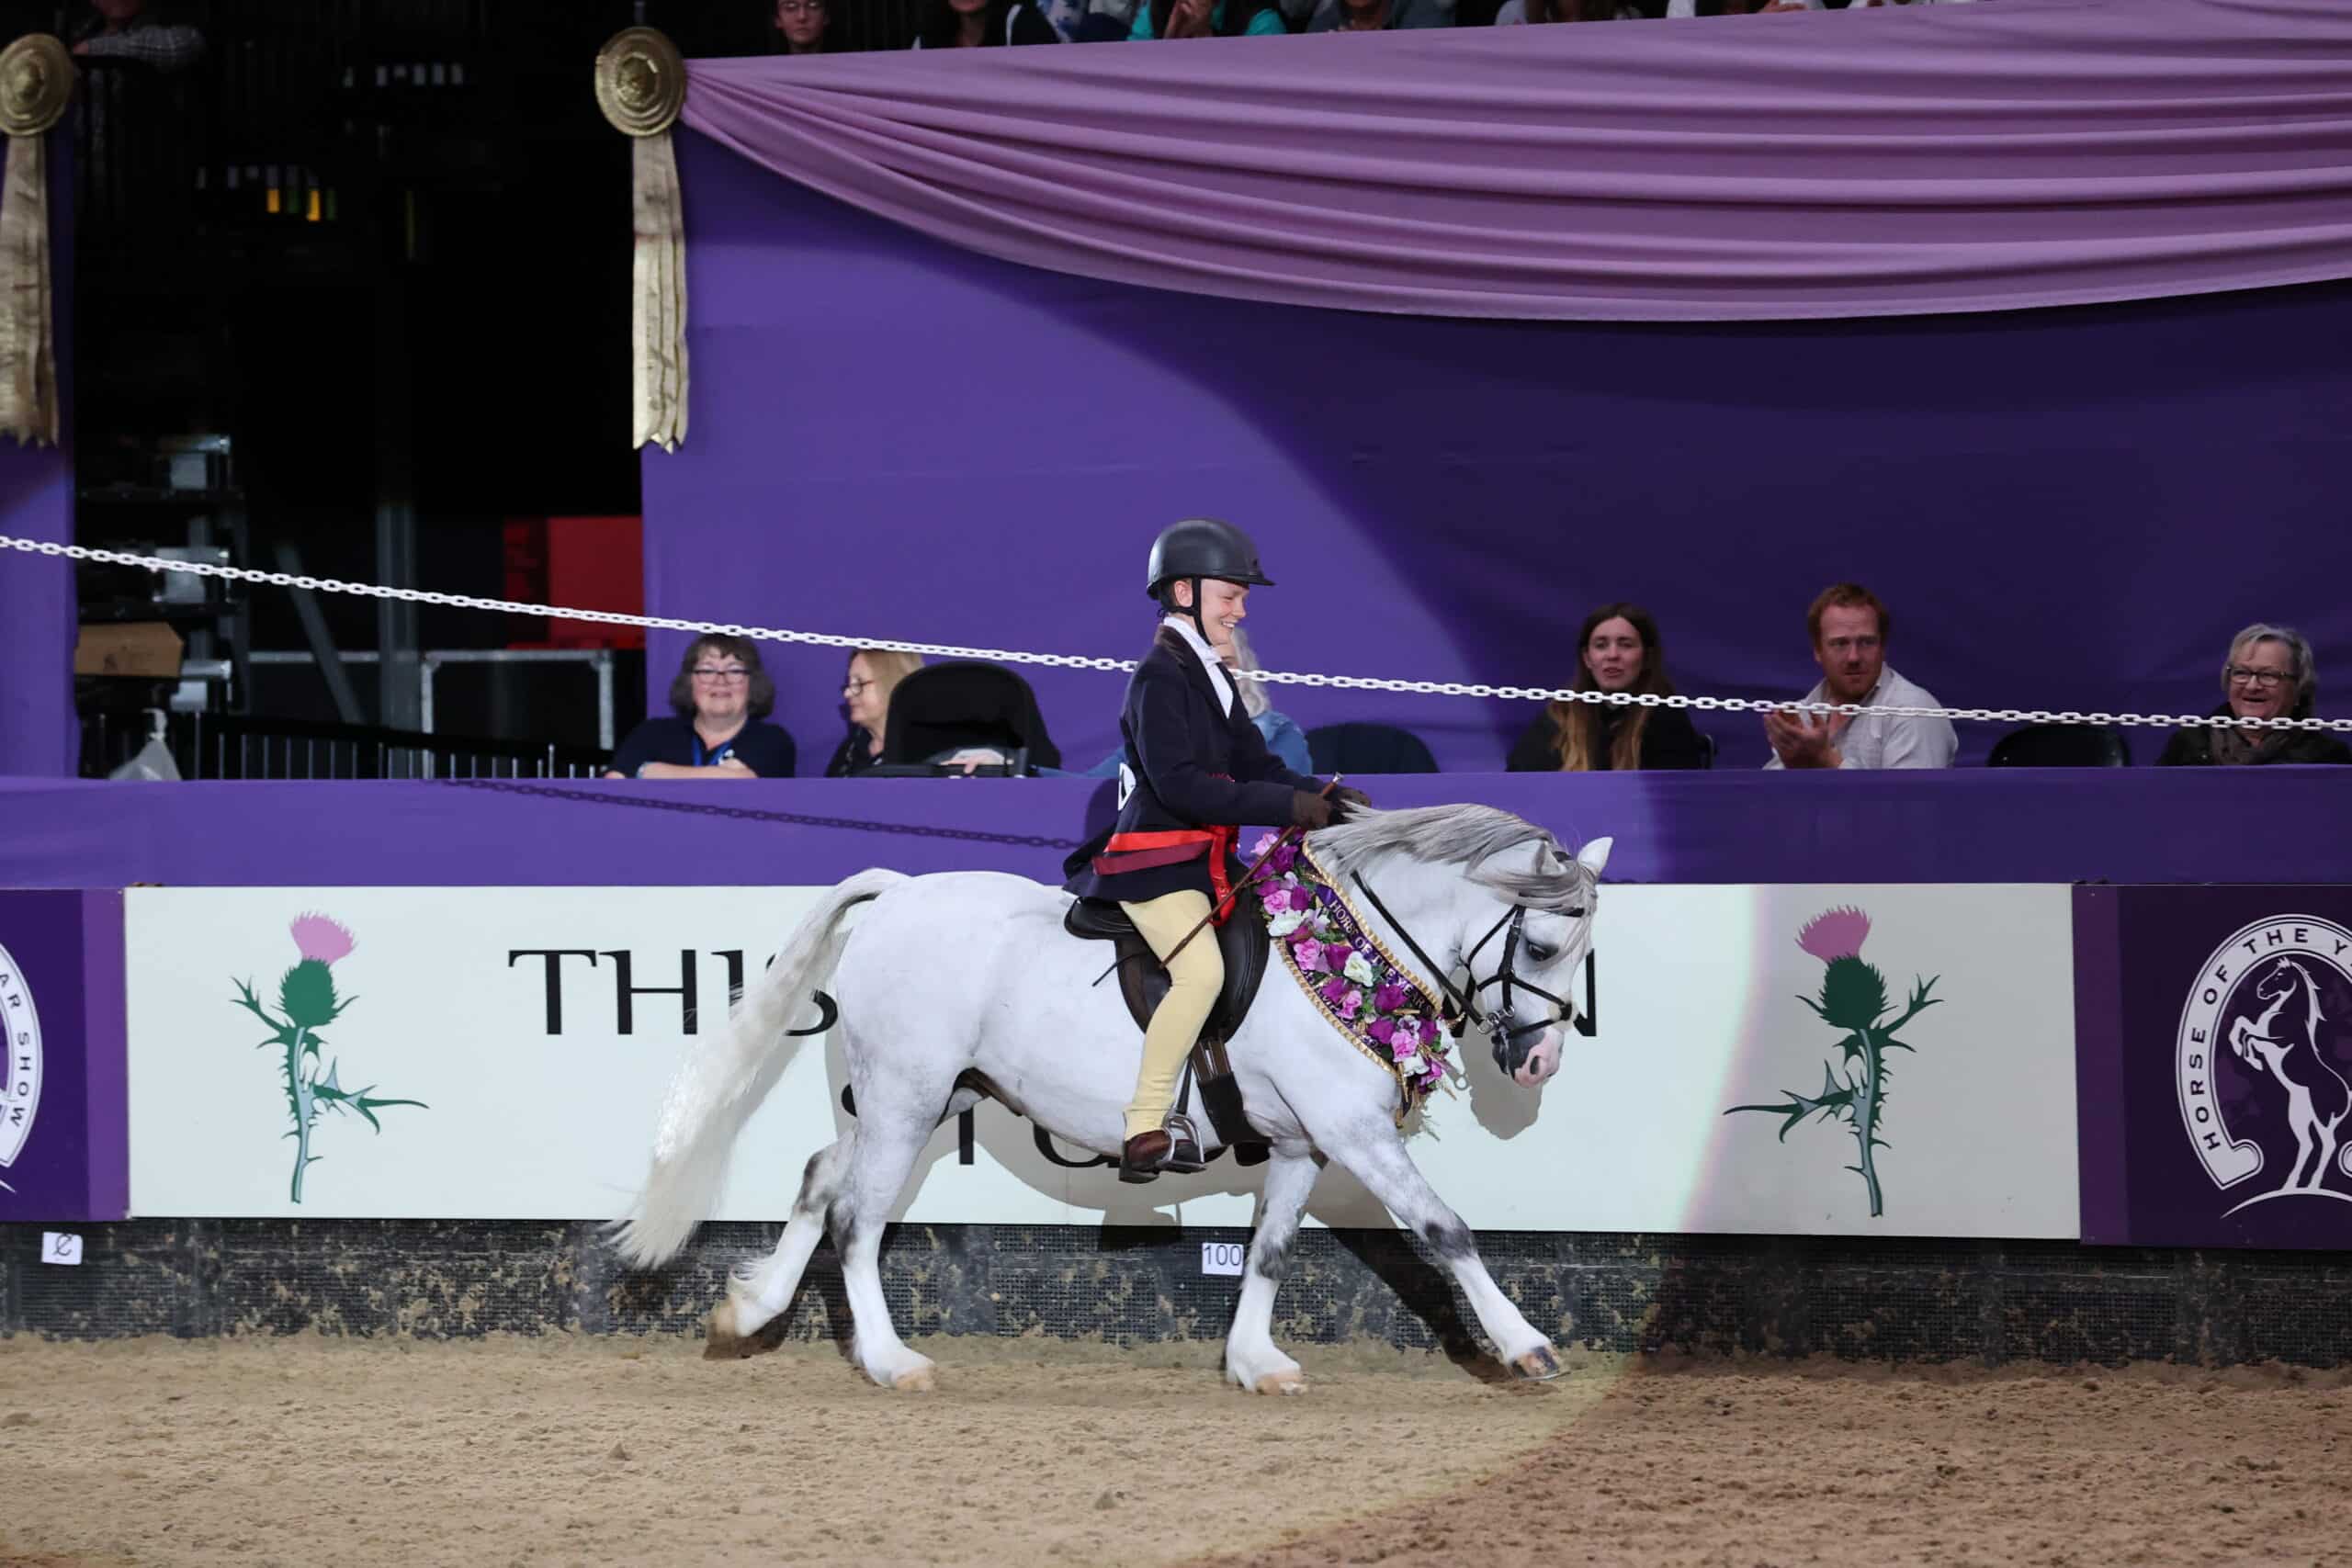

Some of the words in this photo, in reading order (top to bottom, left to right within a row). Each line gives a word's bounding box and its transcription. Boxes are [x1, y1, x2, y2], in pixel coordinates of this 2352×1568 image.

[1354, 936, 1374, 953] OF
[2243, 928, 2308, 954] THE
[2203, 964, 2229, 1005] OF
[9, 1032, 30, 1126] SHOW
[2189, 1026, 2221, 1150] HORSE
[1204, 1245, 1241, 1266] 100
